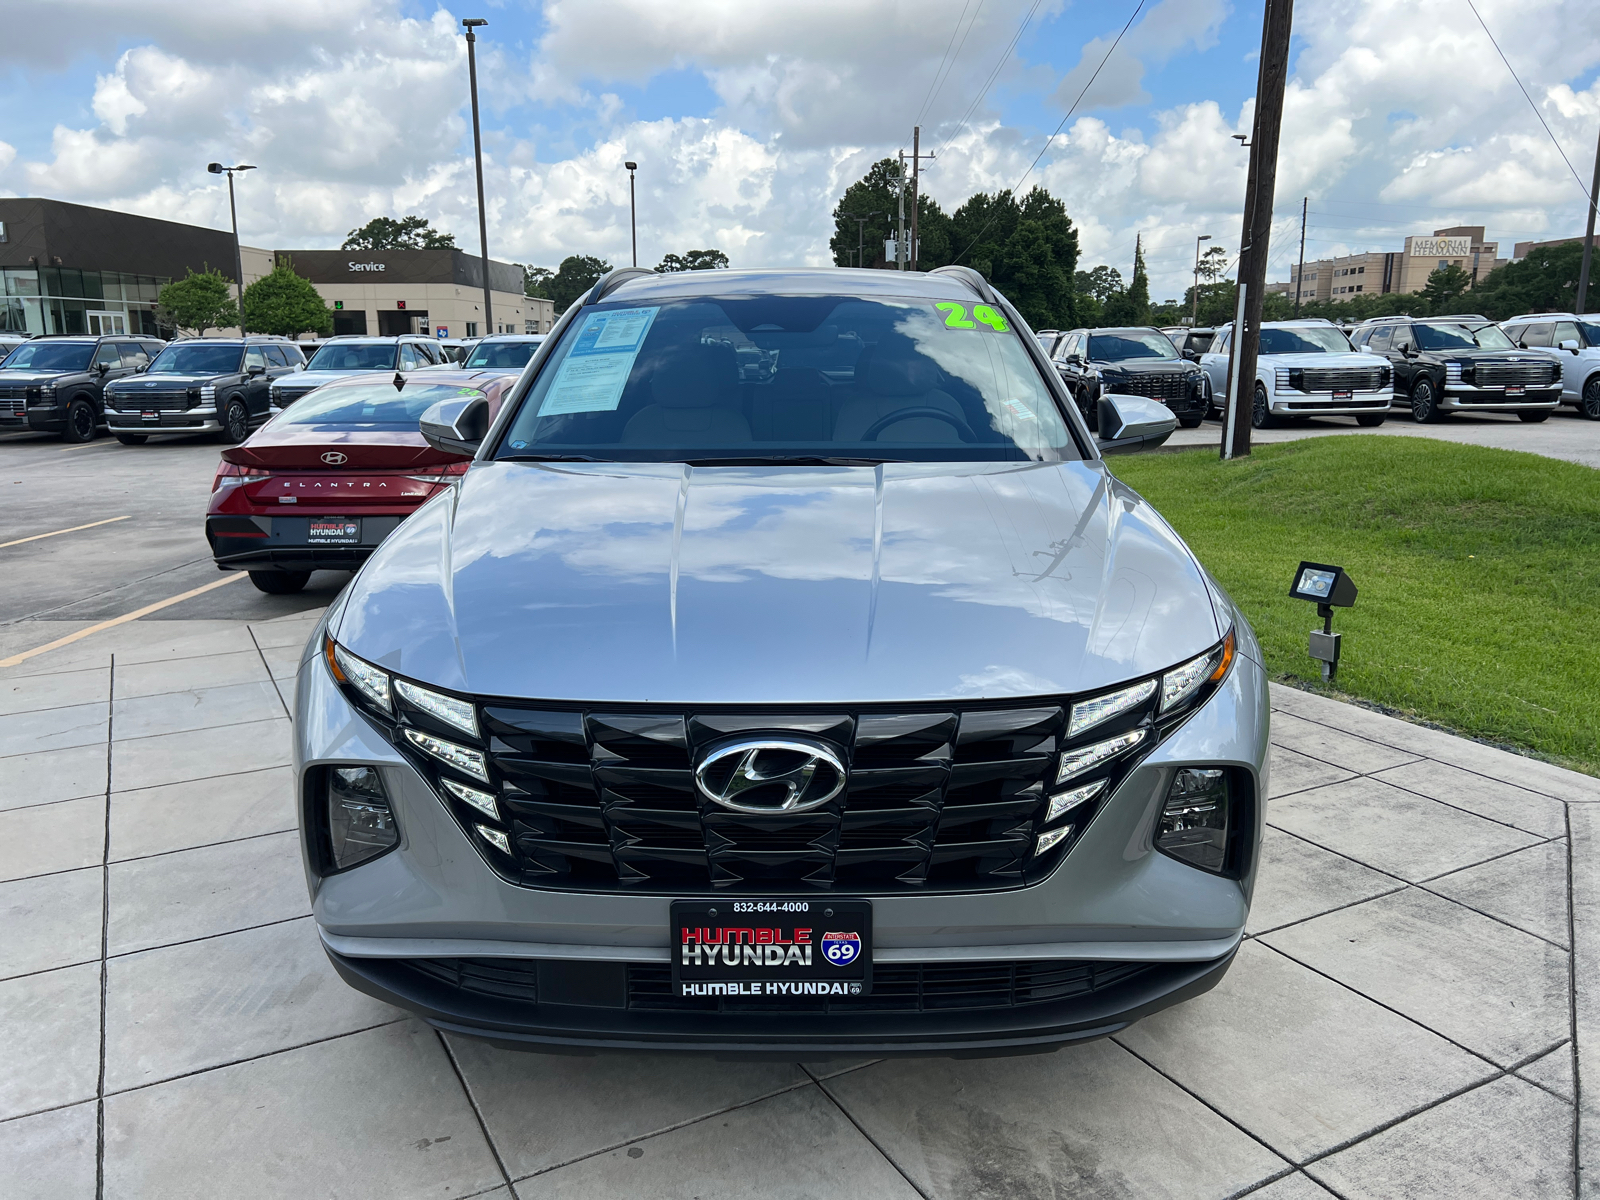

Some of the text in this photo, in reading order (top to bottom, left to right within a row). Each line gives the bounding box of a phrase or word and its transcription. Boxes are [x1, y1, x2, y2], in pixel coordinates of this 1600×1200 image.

[1414, 239, 1468, 248] MEMORIAL
[1413, 247, 1468, 256] HERMANN
[348, 261, 386, 272] Service
[935, 302, 1010, 332] 24
[733, 902, 809, 912] 832-644-4000
[681, 927, 813, 945] HUMBLE
[682, 945, 813, 966] HYUNDAI
[827, 944, 855, 960] 69
[682, 983, 762, 996] HUMBLE
[765, 982, 849, 995] HYUNDAI
